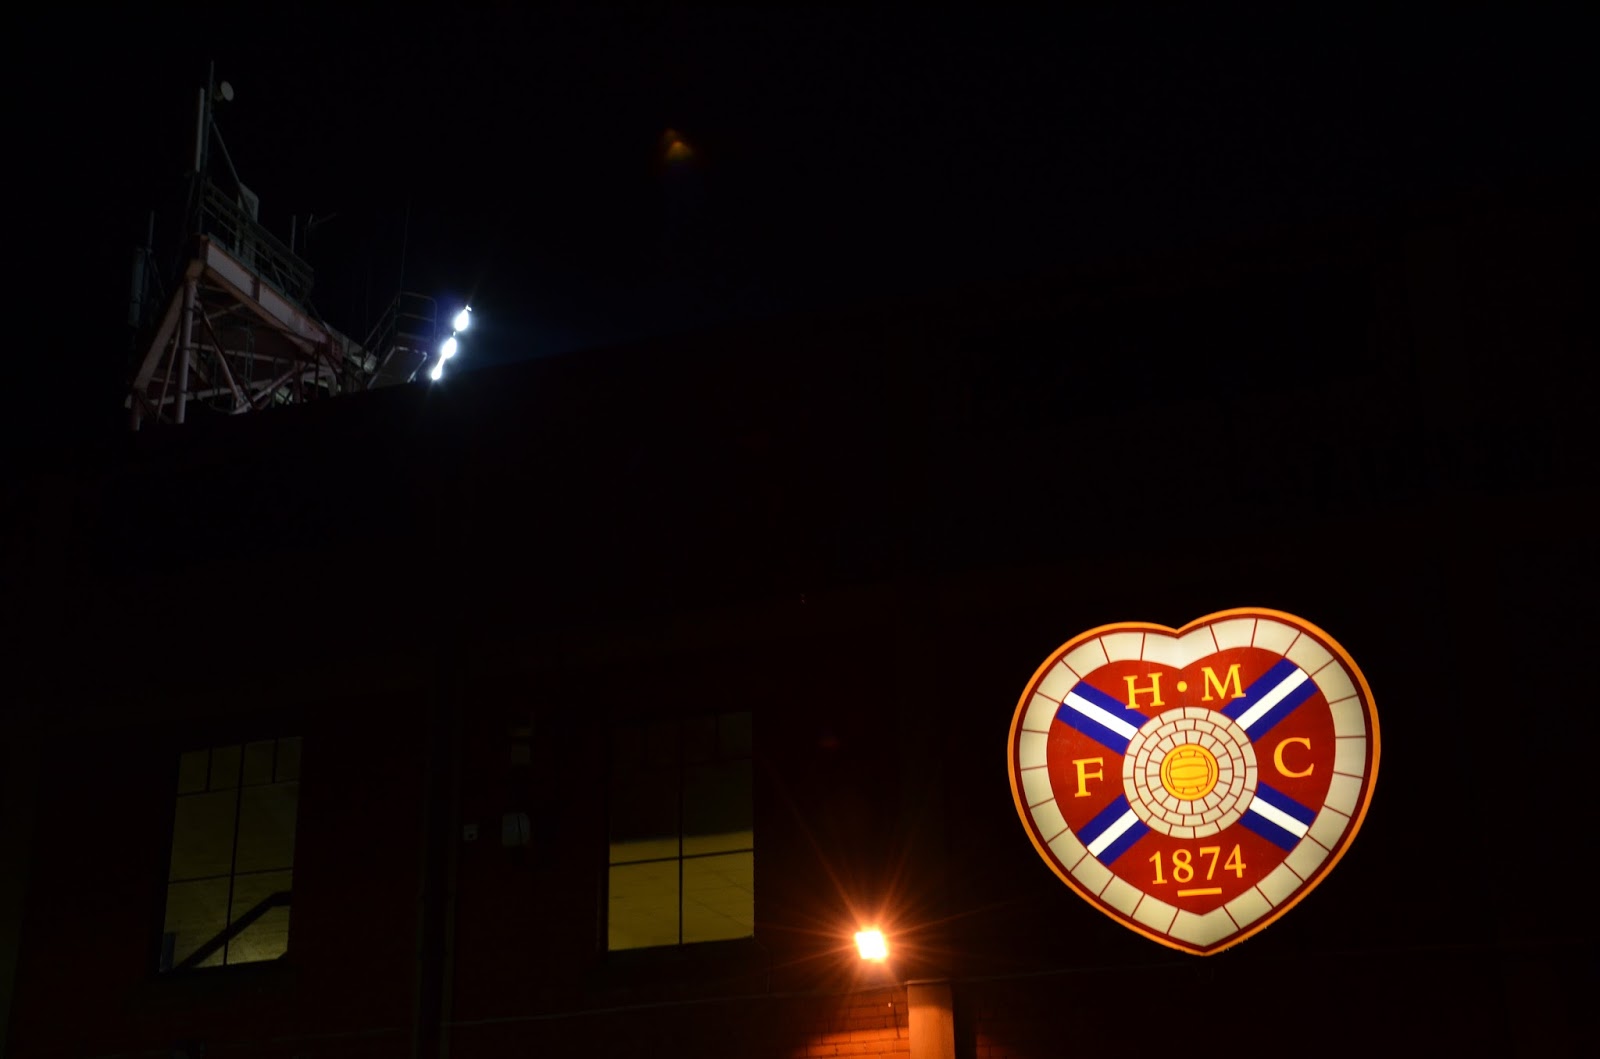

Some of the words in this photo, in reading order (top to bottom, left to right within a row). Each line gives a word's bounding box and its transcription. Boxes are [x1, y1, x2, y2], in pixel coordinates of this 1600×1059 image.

[1072, 757, 1104, 798] F
[1273, 737, 1315, 778] C
[1149, 843, 1247, 885] 1874
